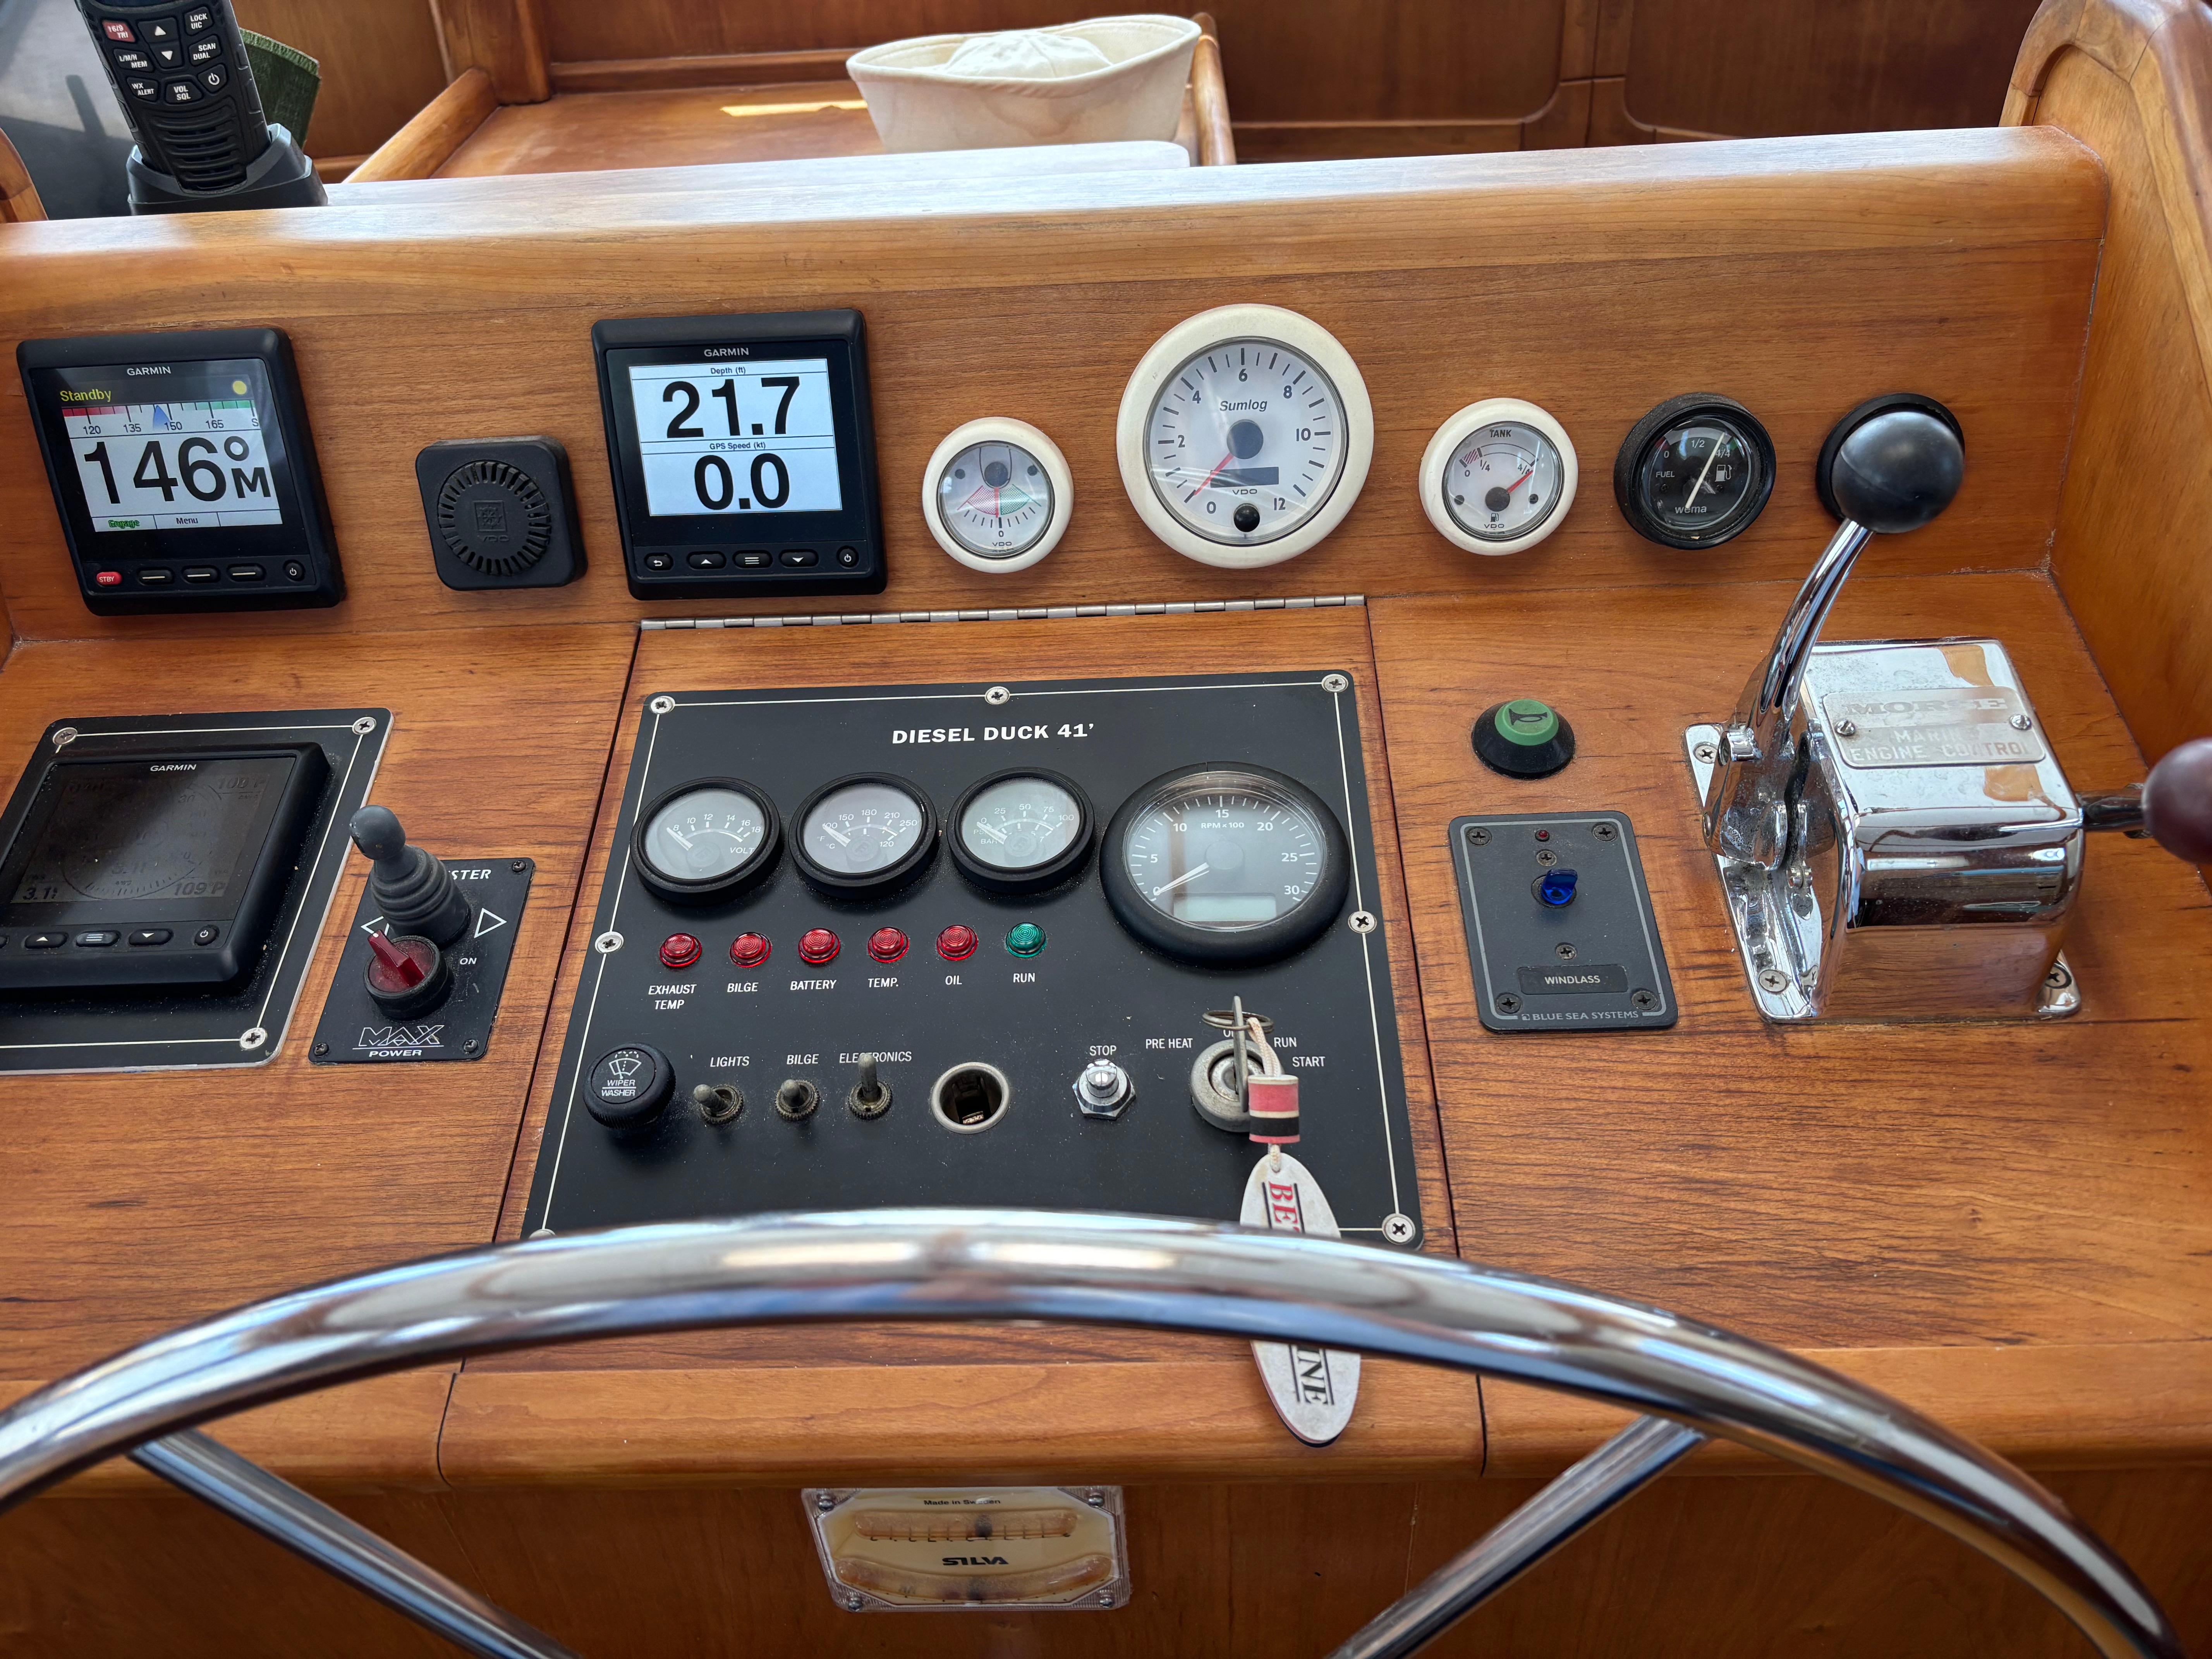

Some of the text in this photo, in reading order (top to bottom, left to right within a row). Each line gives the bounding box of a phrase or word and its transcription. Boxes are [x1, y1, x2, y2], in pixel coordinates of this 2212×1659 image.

[190, 13, 208, 22] LOCK
[198, 43, 216, 51] SCAN
[193, 52, 210, 60] DUAL
[704, 348, 749, 357] GARMIN
[127, 366, 171, 376] GARMIN
[710, 366, 746, 376] Depth (ft)
[1239, 368, 1248, 382] 6
[60, 389, 112, 402] Standby
[1192, 390, 1201, 404] 4
[1283, 385, 1293, 399] 8
[663, 376, 800, 438] 21.7
[1219, 399, 1267, 412] Sumlog
[83, 426, 101, 434] 120
[123, 424, 141, 433] 135
[164, 422, 182, 431] 150
[206, 420, 224, 429] 165
[1296, 428, 1311, 441] 10
[1489, 429, 1512, 438] TANK
[728, 441, 750, 452] Speed
[753, 441, 766, 450] (kt)
[1178, 435, 1186, 448] 2
[1691, 438, 1705, 448] 1/2
[1480, 460, 1491, 471] 1/4
[694, 453, 790, 510] 0.0
[1207, 501, 1216, 514] 0
[1274, 498, 1286, 510] 12
[109, 519, 140, 528] Engage
[177, 516, 198, 525] Menu
[892, 728, 975, 744] DIESEL
[984, 725, 1049, 740] DUCK
[1850, 745, 1927, 761] ENGINE
[1216, 809, 1229, 818] 15
[1173, 823, 1187, 832] 10
[1257, 823, 1273, 831] 20
[1150, 854, 1158, 863] 5
[1281, 853, 1298, 862] 25
[448, 869, 491, 880] STER
[1284, 885, 1300, 895] 30
[868, 977, 899, 988] TEMP.
[945, 975, 962, 985] OIL
[1013, 973, 1035, 983] RUN
[1544, 975, 1601, 985] WINDLASS
[648, 984, 697, 995] EXHAUST
[727, 982, 759, 993] BILGE
[790, 979, 837, 991] BATTERY
[654, 1000, 684, 1010] TEMP
[1592, 1011, 1639, 1019] SYSTEMS
[358, 1025, 445, 1046] MAX
[1146, 1038, 1193, 1049] PRE HEAT
[1274, 1037, 1297, 1048] RUN
[1089, 1045, 1116, 1056] STOP
[710, 1056, 749, 1067] LIGHTS
[787, 1054, 819, 1065] BILGE
[839, 1051, 912, 1063] ELERONICS
[1292, 1056, 1325, 1067] START
[942, 1557, 1009, 1566] SILVA
